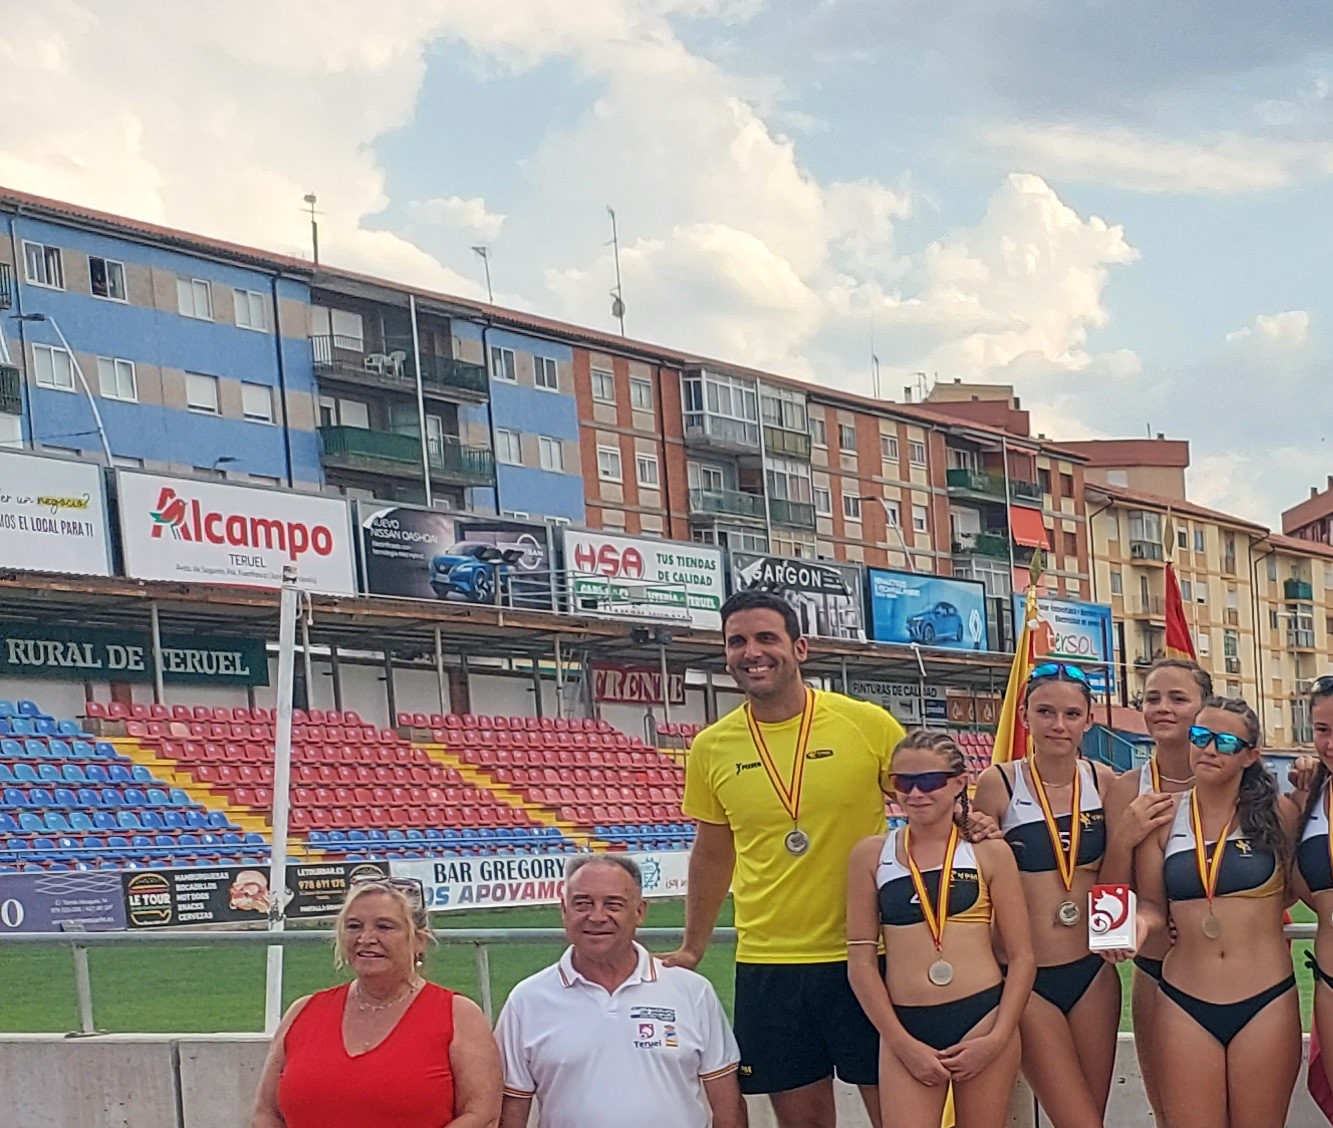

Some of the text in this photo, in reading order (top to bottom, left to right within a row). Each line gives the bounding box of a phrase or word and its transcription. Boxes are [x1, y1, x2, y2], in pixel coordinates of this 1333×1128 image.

[18, 515, 28, 531] EL
[31, 517, 59, 534] LOCAL
[60, 520, 84, 536] PARA
[85, 522, 94, 537] TI
[149, 487, 333, 561] Alcampo
[370, 528, 401, 540] NISSAN
[228, 553, 267, 568] TERUEL
[575, 543, 643, 579] HSA
[656, 553, 716, 571] TUS TIENDAS
[658, 570, 712, 586] DE CALIDAD
[7, 638, 250, 676] RURAL DE TERUEL
[853, 682, 891, 696] PINTURAS
[893, 685, 902, 697] DE
[434, 857, 566, 884] BAR GREGORY
[128, 893, 172, 906] LE TOUR
[633, 1039, 662, 1049] Teruel
